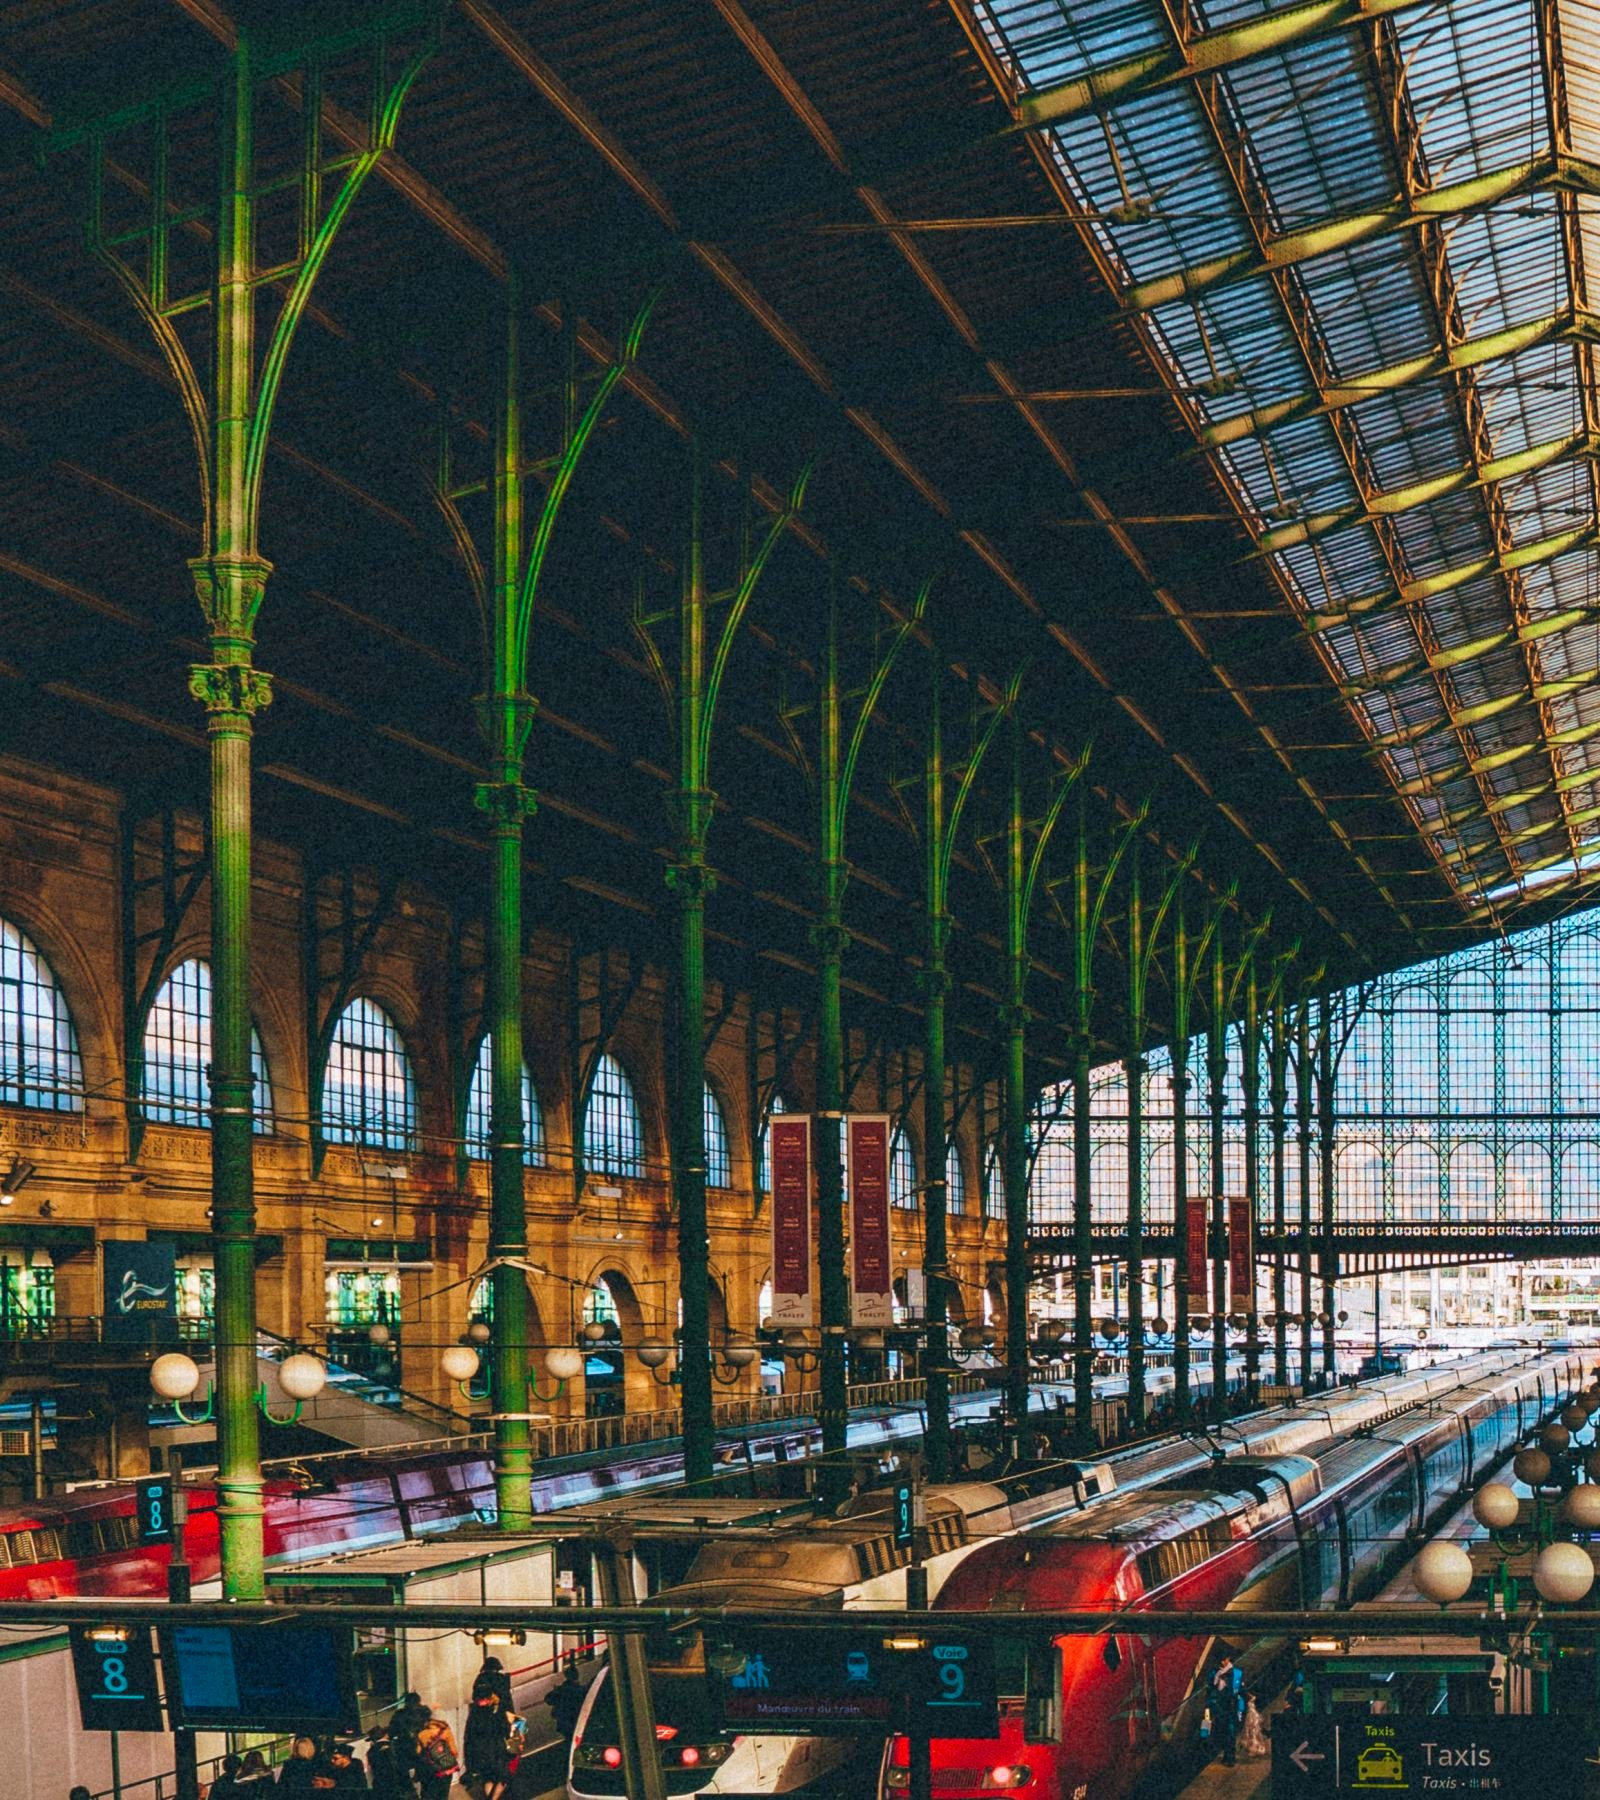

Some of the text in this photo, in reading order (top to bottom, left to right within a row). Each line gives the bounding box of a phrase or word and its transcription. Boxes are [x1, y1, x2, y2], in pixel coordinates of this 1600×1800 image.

[136, 1300, 167, 1309] EUROSTAR
[151, 1500, 161, 1529] 8
[901, 1503, 908, 1532] 9
[937, 1647, 964, 1658] Voie
[102, 1657, 128, 1692] 8
[940, 1663, 964, 1699] 9
[757, 1703, 861, 1713] Manœuvre du train
[1364, 1725, 1395, 1736] Taxis
[1420, 1742, 1491, 1767] Taxis
[1422, 1776, 1457, 1789] Taxis
